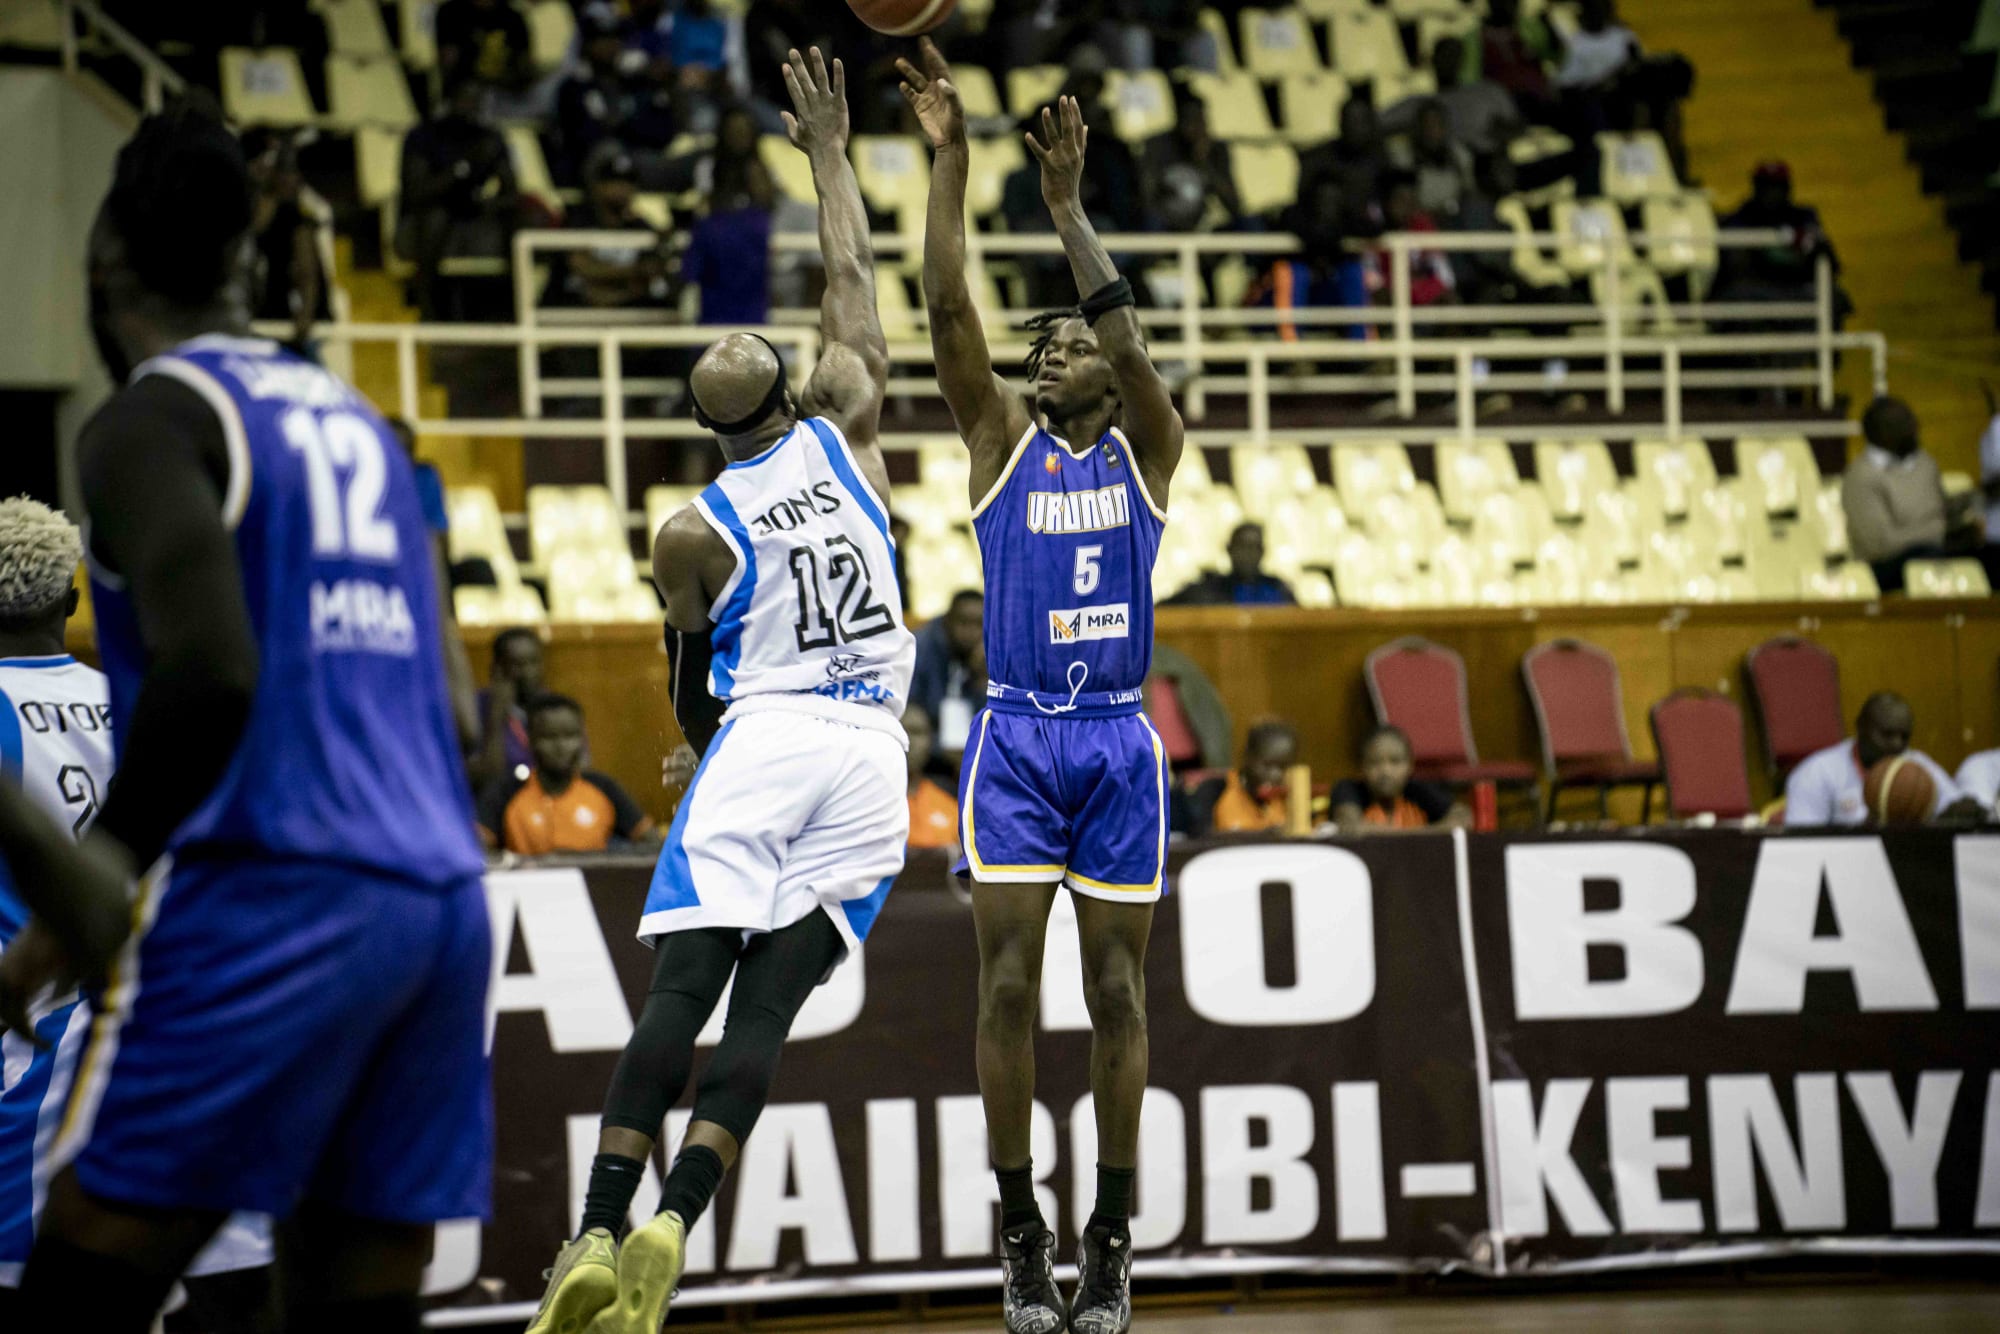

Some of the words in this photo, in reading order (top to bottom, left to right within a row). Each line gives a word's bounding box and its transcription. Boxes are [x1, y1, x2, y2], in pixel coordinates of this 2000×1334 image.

[281, 406, 399, 563] 12
[789, 534, 896, 653] 12
[1073, 544, 1103, 596] 5
[1087, 612, 1126, 628] MIRA
